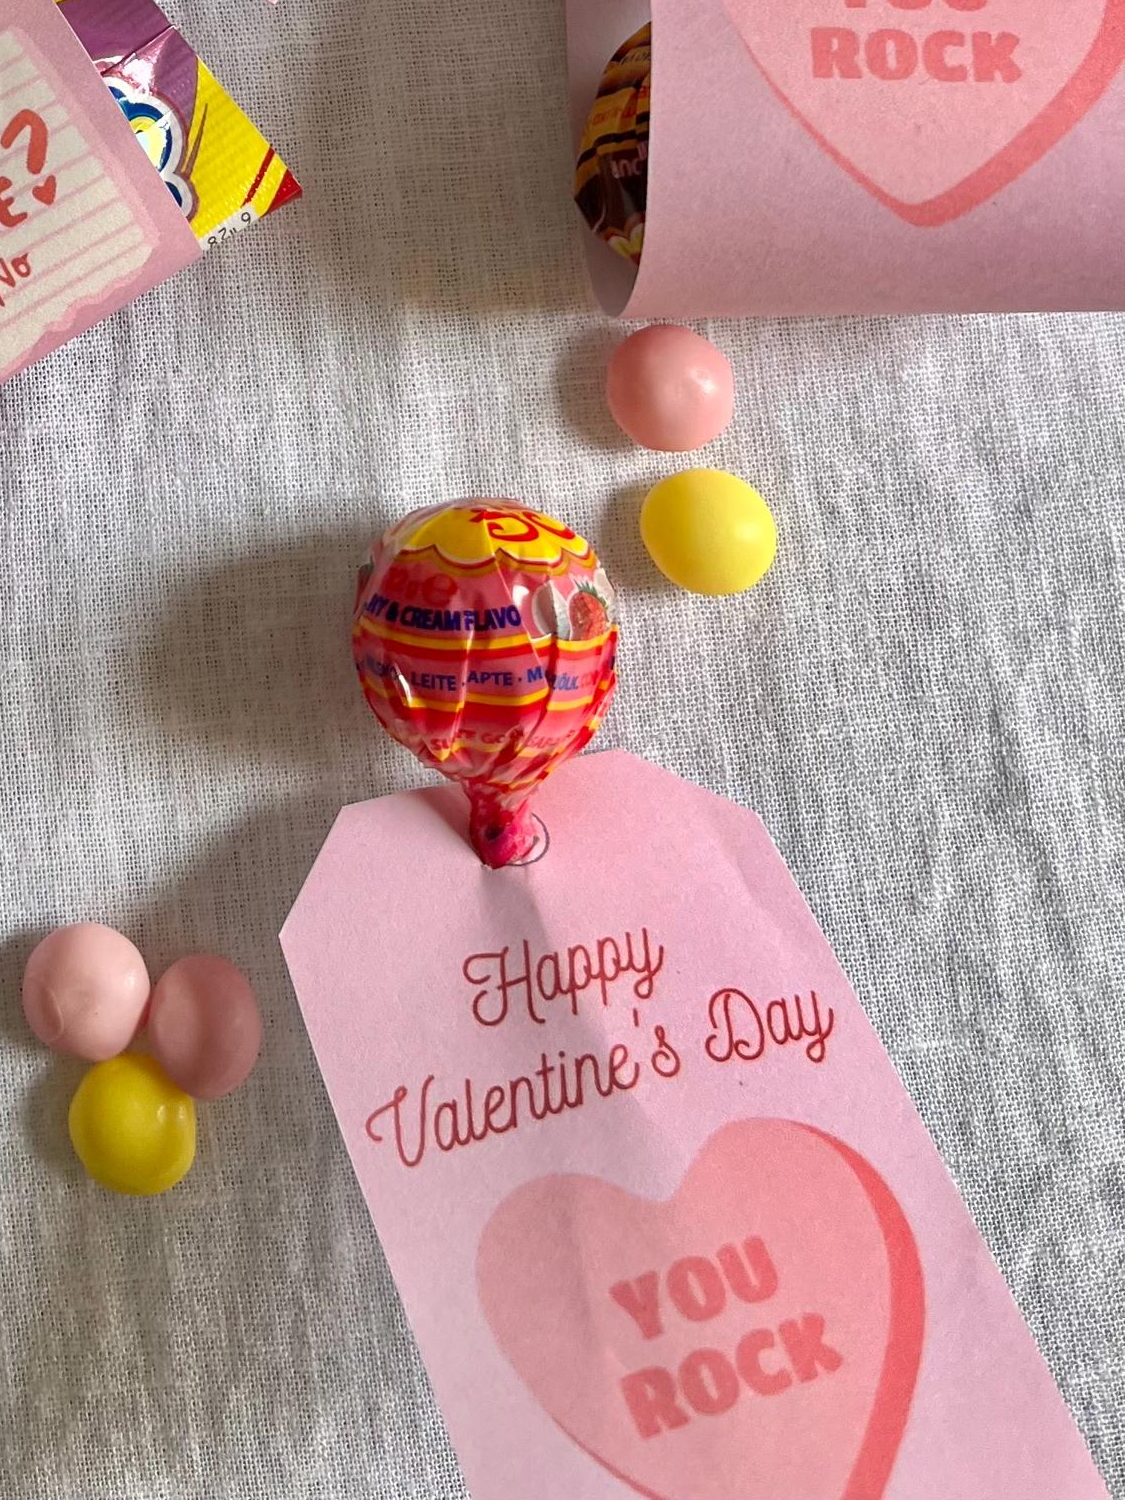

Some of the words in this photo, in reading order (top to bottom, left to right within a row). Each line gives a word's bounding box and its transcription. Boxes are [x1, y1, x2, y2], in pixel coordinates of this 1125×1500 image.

[810, 27, 1023, 83] ROCK
[400, 606, 461, 631] CREAM
[410, 673, 456, 691] LEITE
[463, 925, 665, 1027] Happy
[365, 1007, 682, 1168] Valentine's
[705, 987, 835, 1064] Day
[608, 1234, 782, 1342] YOU
[618, 1310, 845, 1441] ROCK
